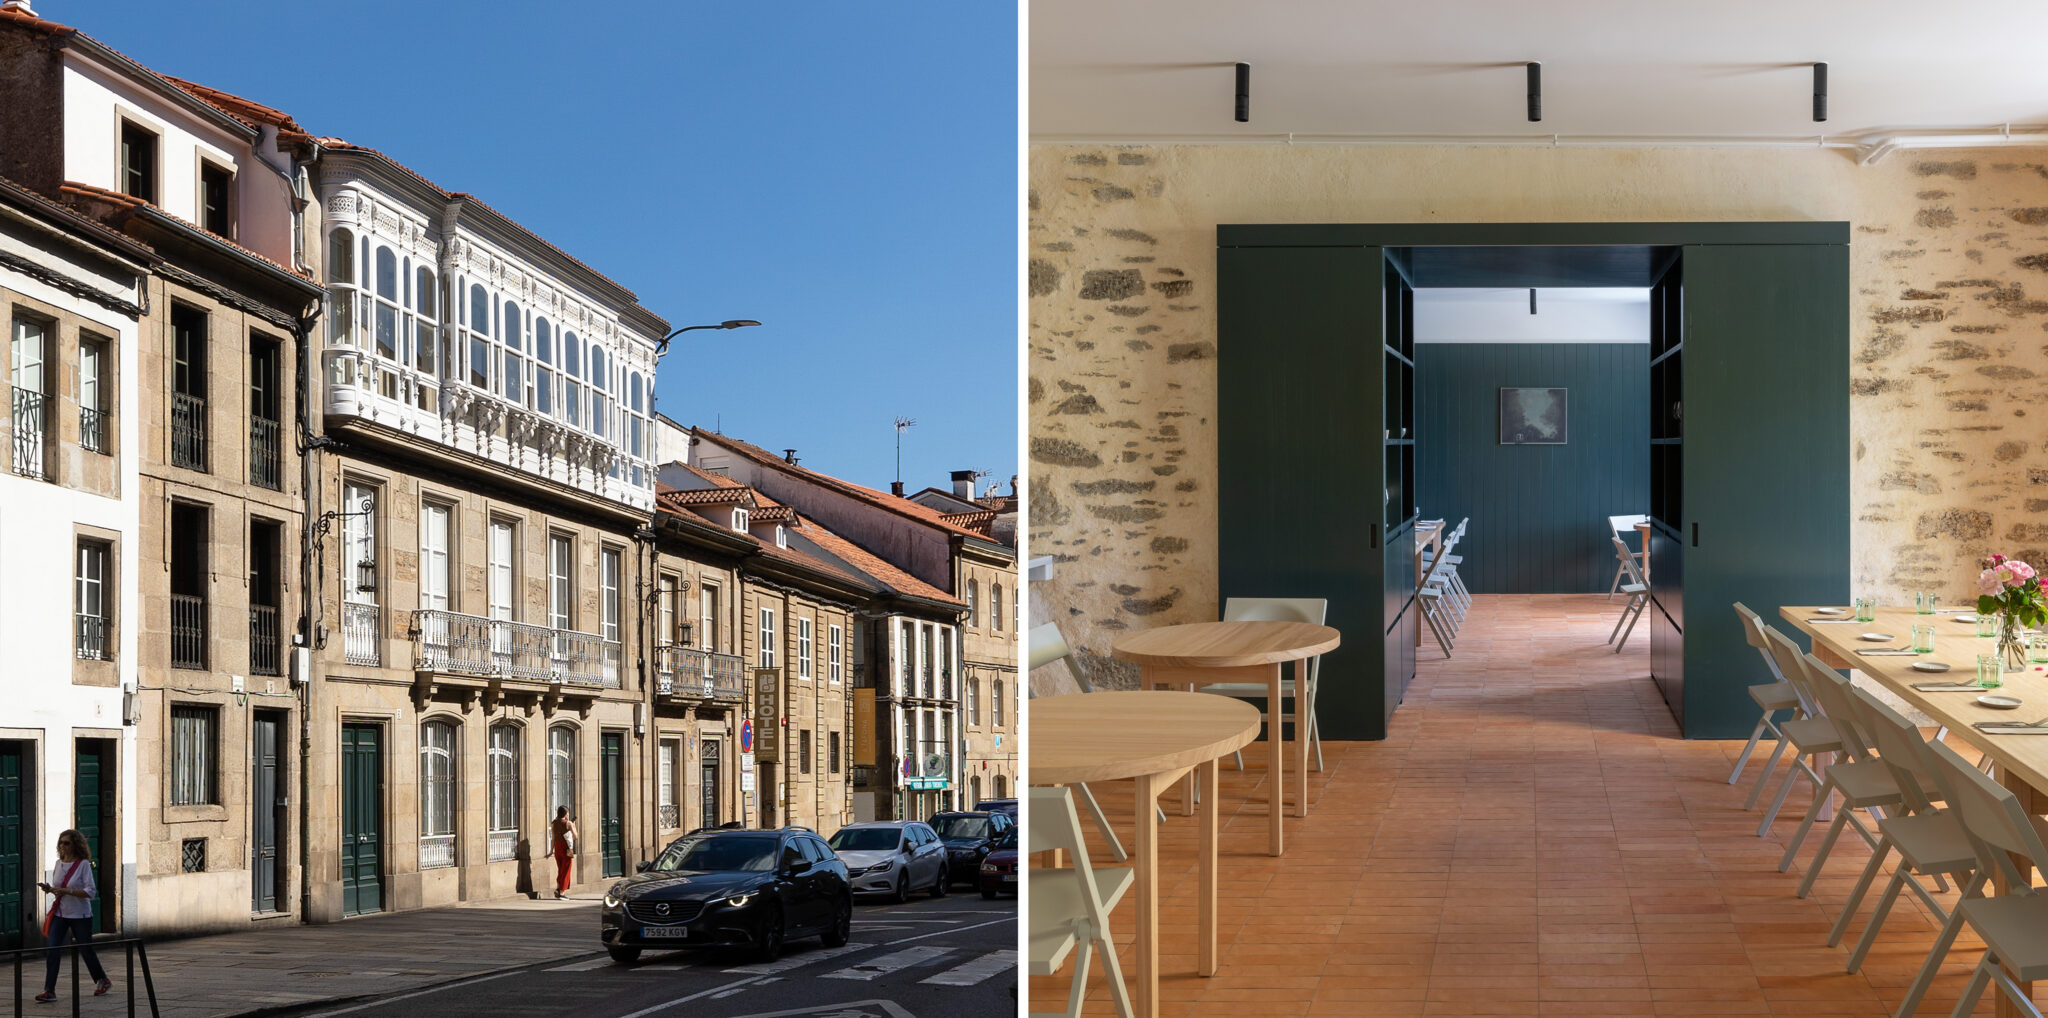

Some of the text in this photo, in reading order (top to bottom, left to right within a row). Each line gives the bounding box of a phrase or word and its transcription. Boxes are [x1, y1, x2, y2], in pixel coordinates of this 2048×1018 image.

[759, 694, 775, 750] HOTEL
[645, 928, 685, 936] 7592 KGV
